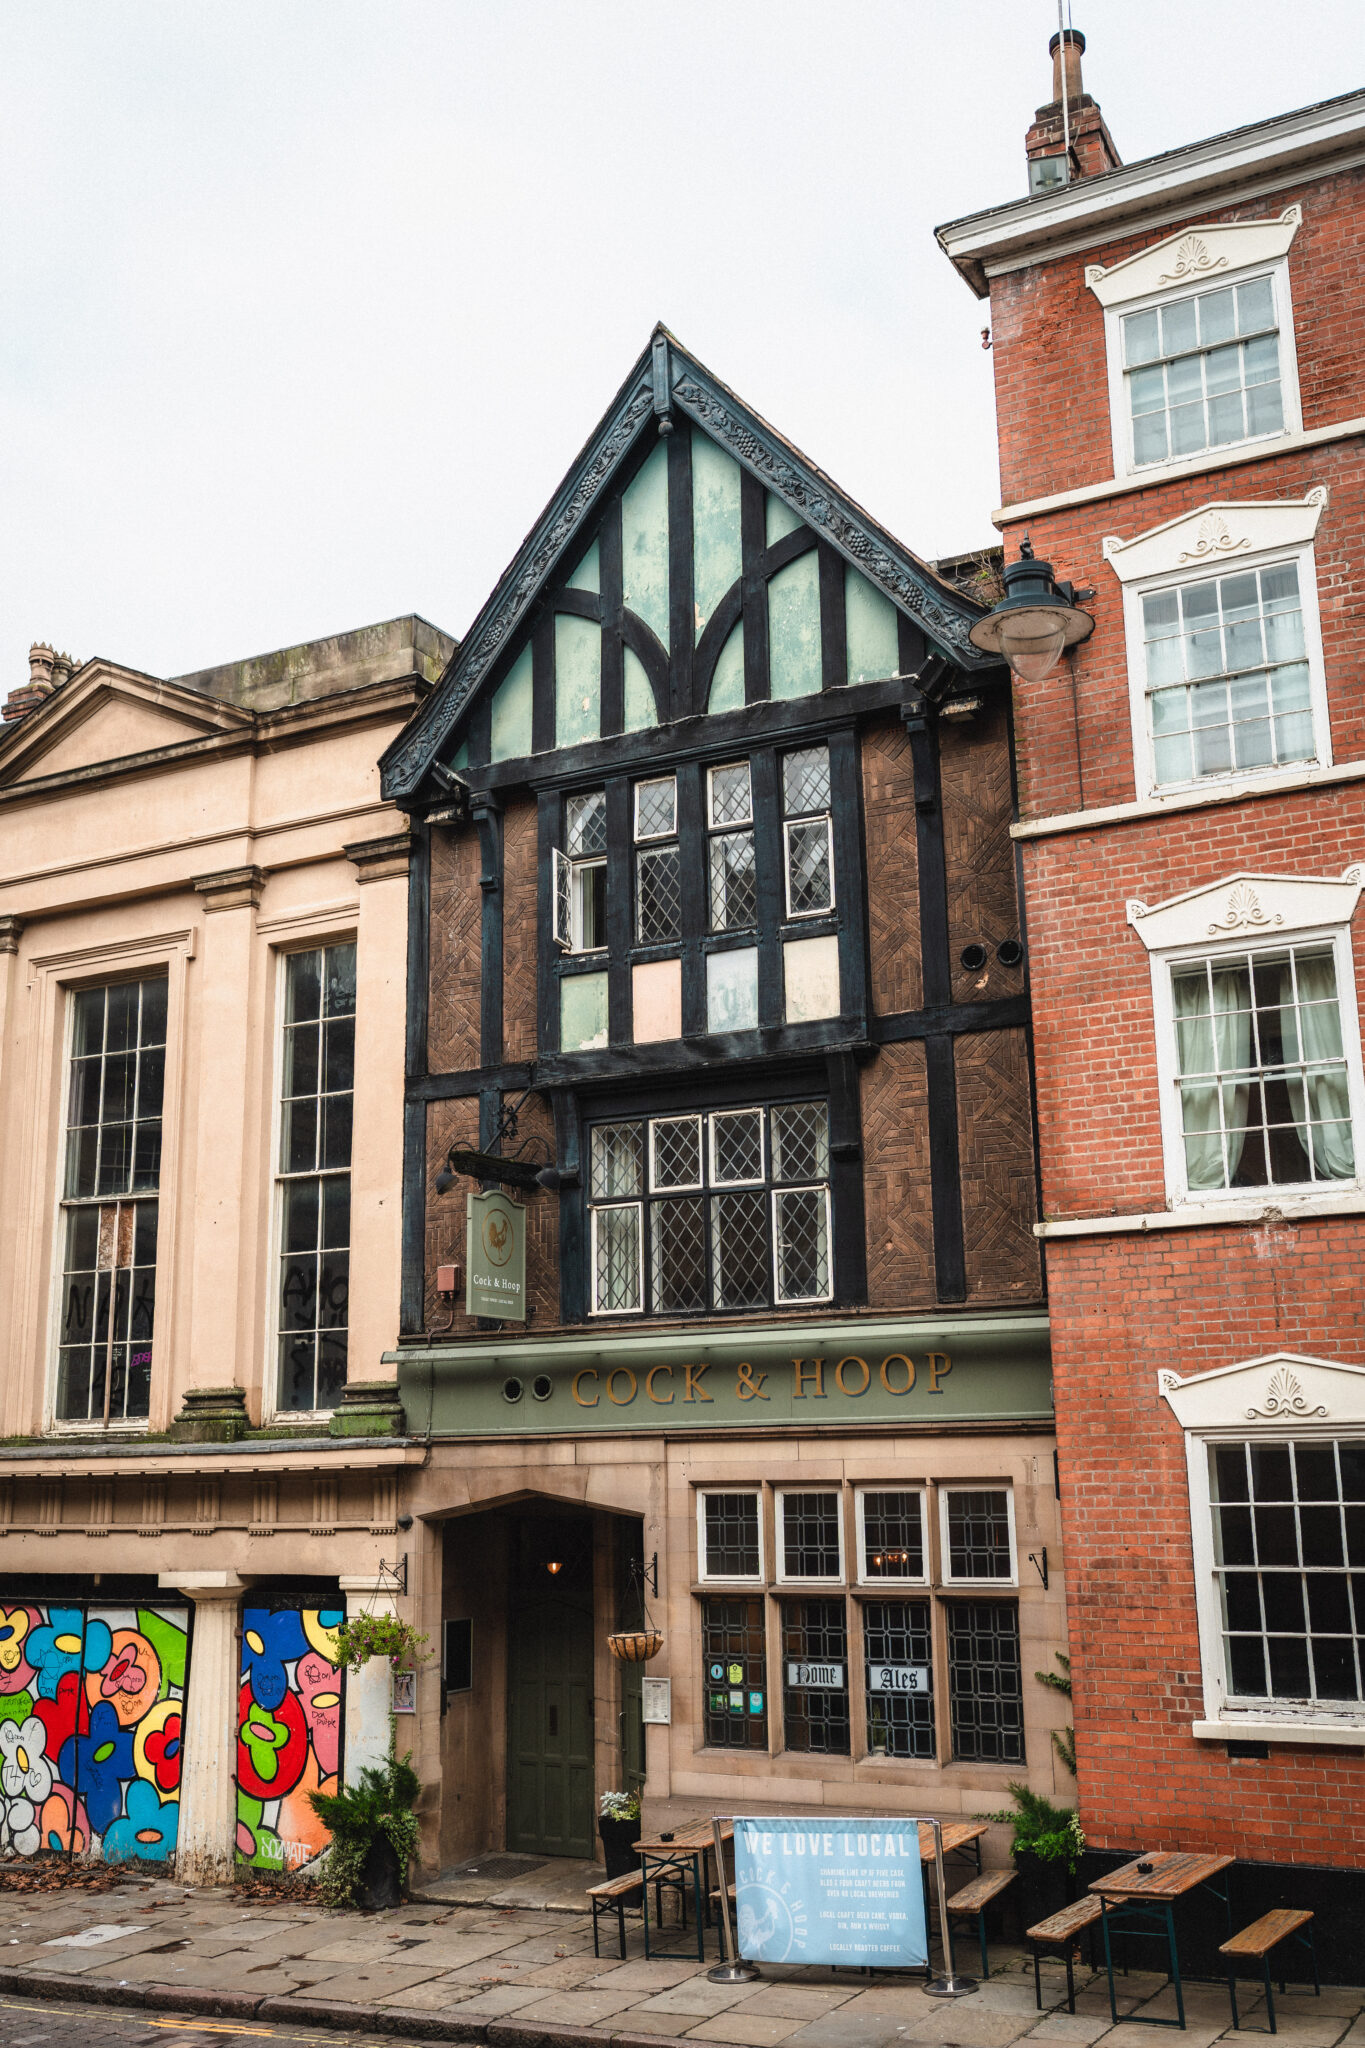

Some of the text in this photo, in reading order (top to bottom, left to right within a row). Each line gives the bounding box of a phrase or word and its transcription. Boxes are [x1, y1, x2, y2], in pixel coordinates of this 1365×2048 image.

[473, 1274, 520, 1293] Cock & Hoop
[571, 1352, 954, 1408] COCK & HOOP
[796, 1664, 918, 1689] Home Ales
[744, 1832, 910, 1857] WE LOVE LOCAL
[827, 1889, 839, 1897] OVER
[850, 1890, 866, 1898] LOCAL
[868, 1890, 899, 1898] BREWERIES
[891, 1880, 905, 1888] FROM
[790, 1899, 808, 1949] HOOP
[820, 1911, 835, 1919] LOCAL
[837, 1911, 854, 1919] CRAFT
[829, 1943, 852, 1951] LOCALLY
[880, 1944, 901, 1952] COFFEE
